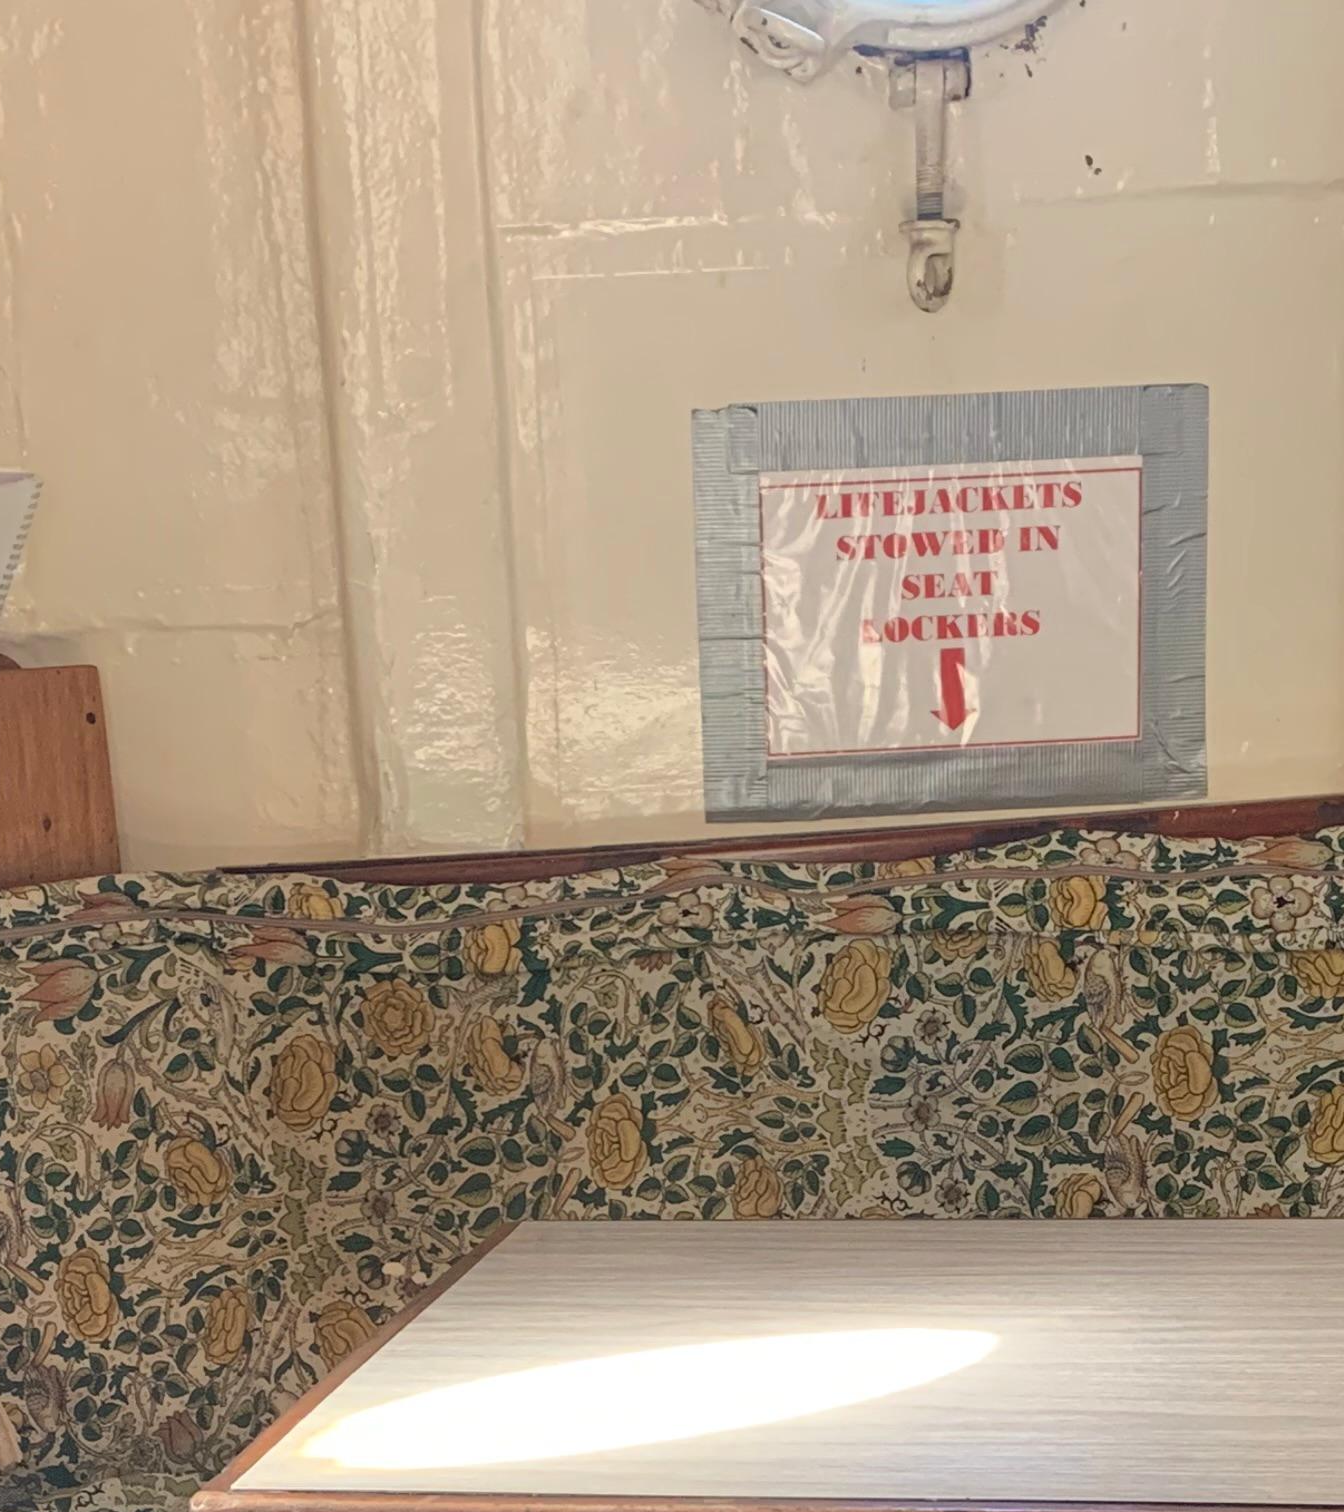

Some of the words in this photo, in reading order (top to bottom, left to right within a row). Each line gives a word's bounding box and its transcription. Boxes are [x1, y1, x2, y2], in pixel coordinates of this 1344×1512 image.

[814, 481, 1083, 521] LIFEJACKETS
[835, 529, 1006, 561] STOWED
[1017, 525, 1061, 553] IN
[900, 571, 998, 601] SEAT
[862, 610, 1041, 644] LOCKERS
